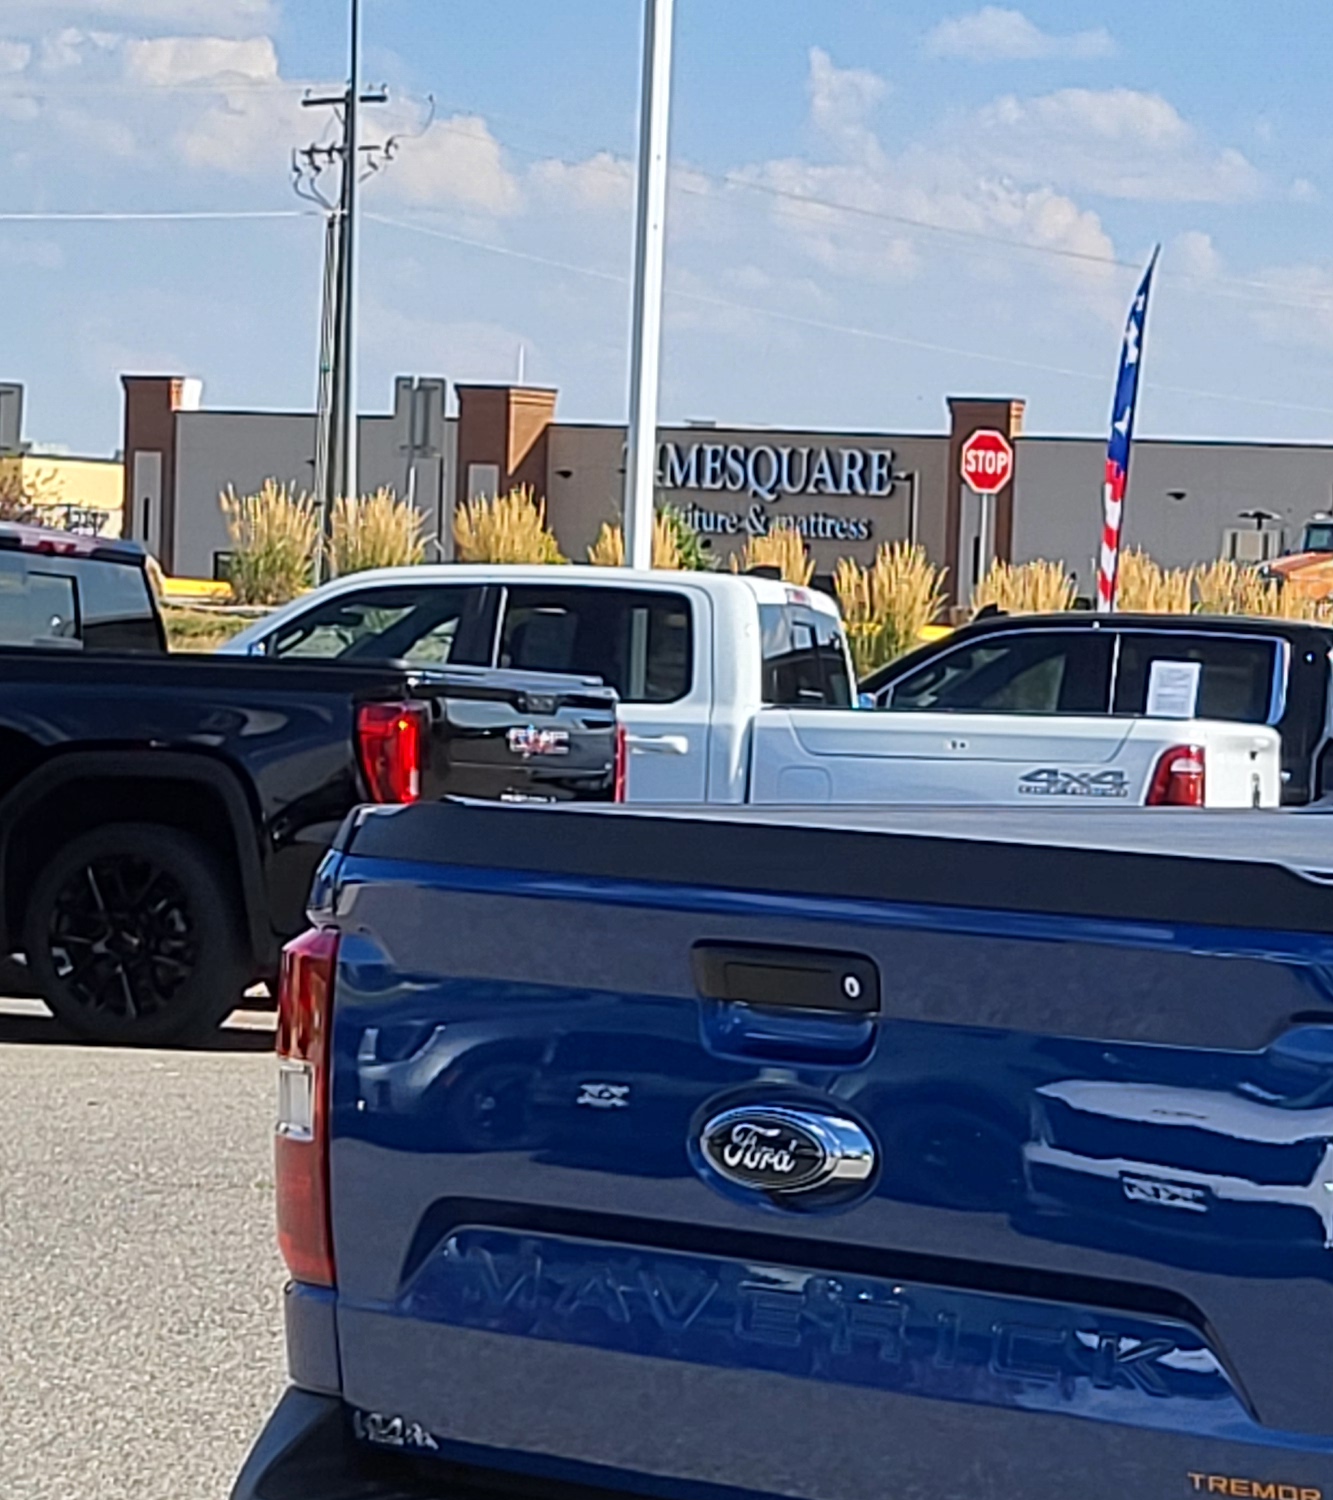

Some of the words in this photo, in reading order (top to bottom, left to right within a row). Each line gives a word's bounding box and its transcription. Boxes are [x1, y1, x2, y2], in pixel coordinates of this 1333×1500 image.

[622, 442, 896, 501] MESQUARE
[966, 449, 1008, 475] STOP
[724, 1123, 797, 1173] Ford
[462, 1242, 1176, 1398] MAVERICK
